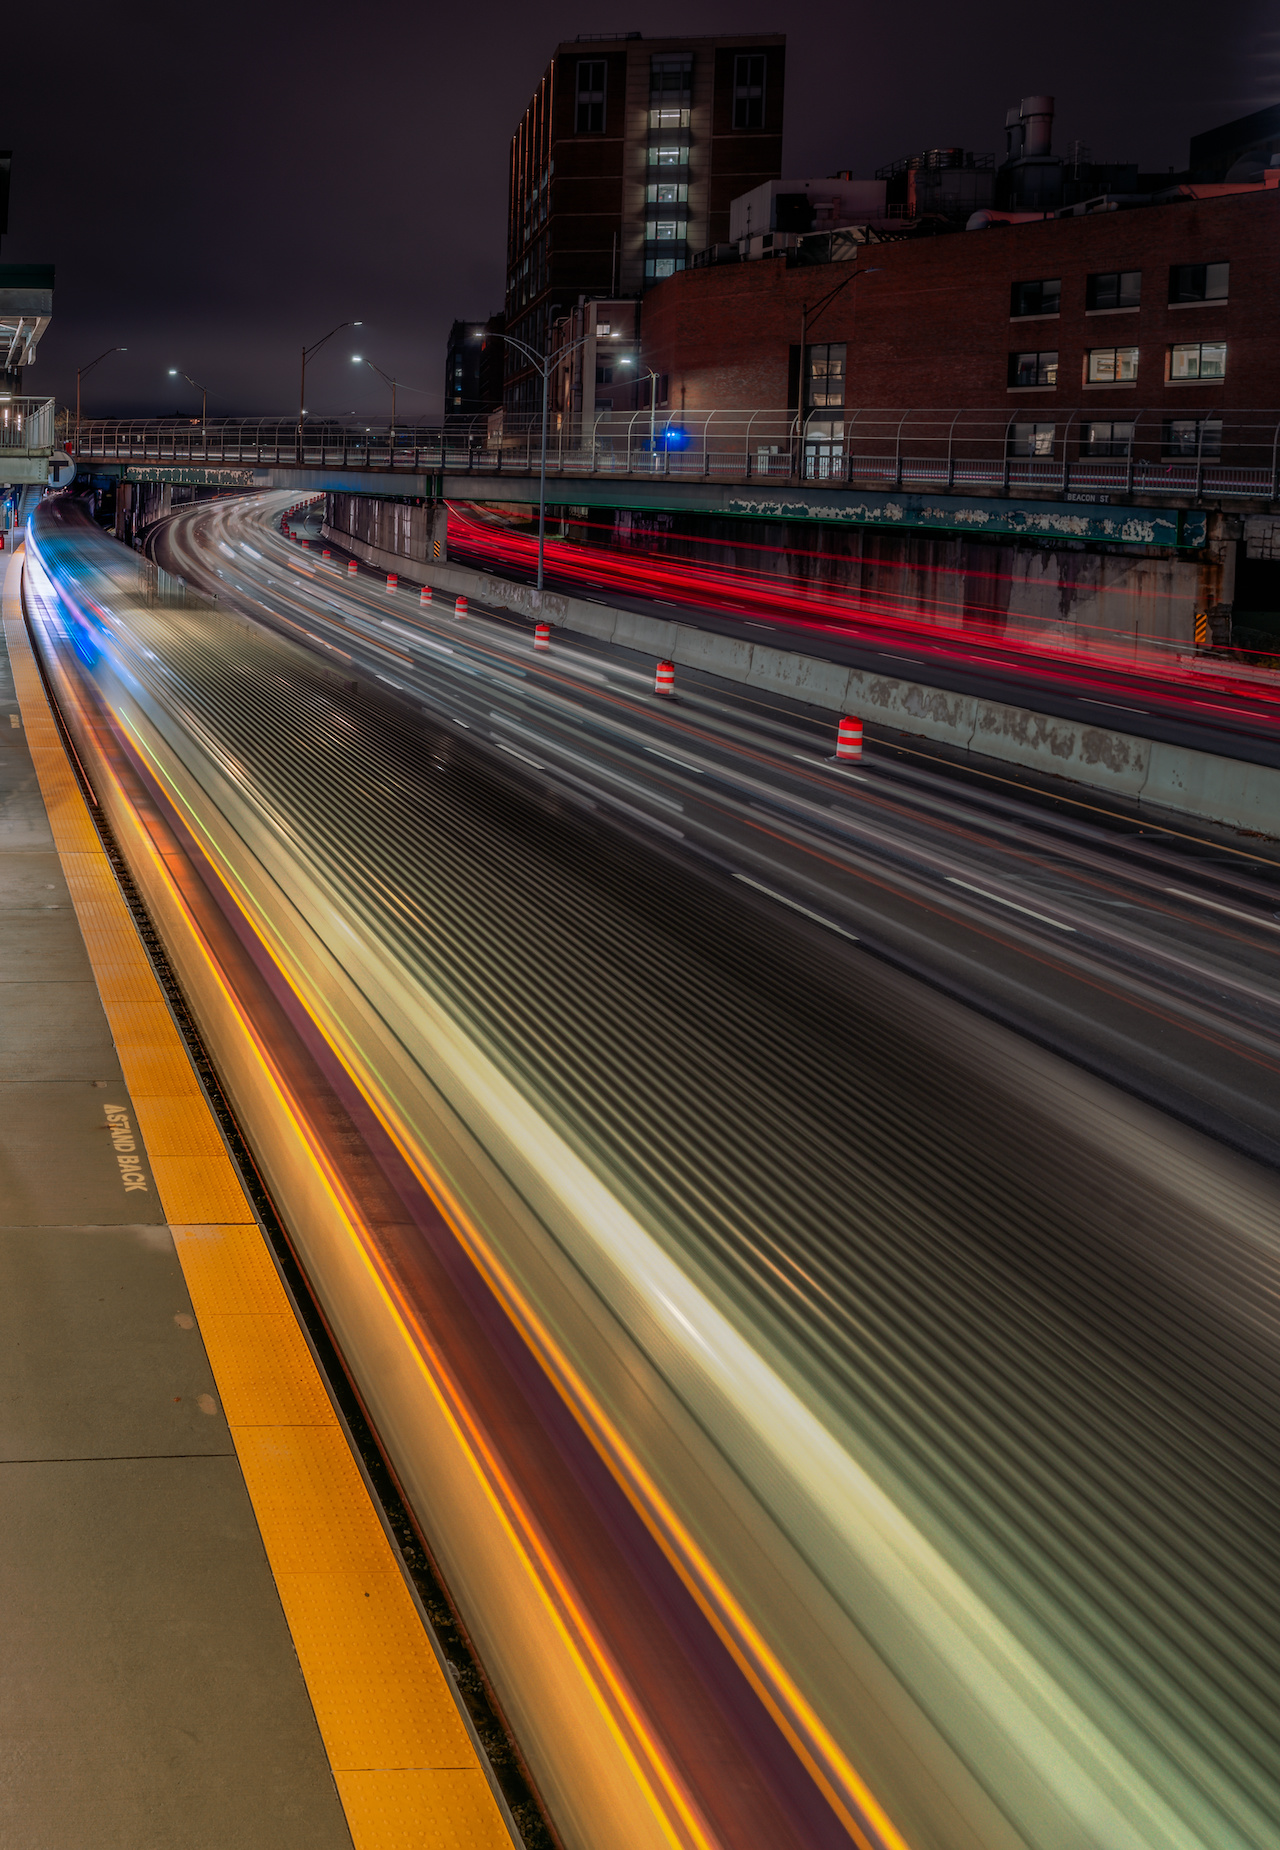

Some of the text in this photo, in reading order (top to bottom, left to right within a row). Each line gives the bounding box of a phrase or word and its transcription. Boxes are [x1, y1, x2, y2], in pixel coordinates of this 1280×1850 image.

[49, 460, 69, 482] T
[1067, 493, 1109, 503] BEACON ST
[106, 1114, 148, 1192] STAND BACK
